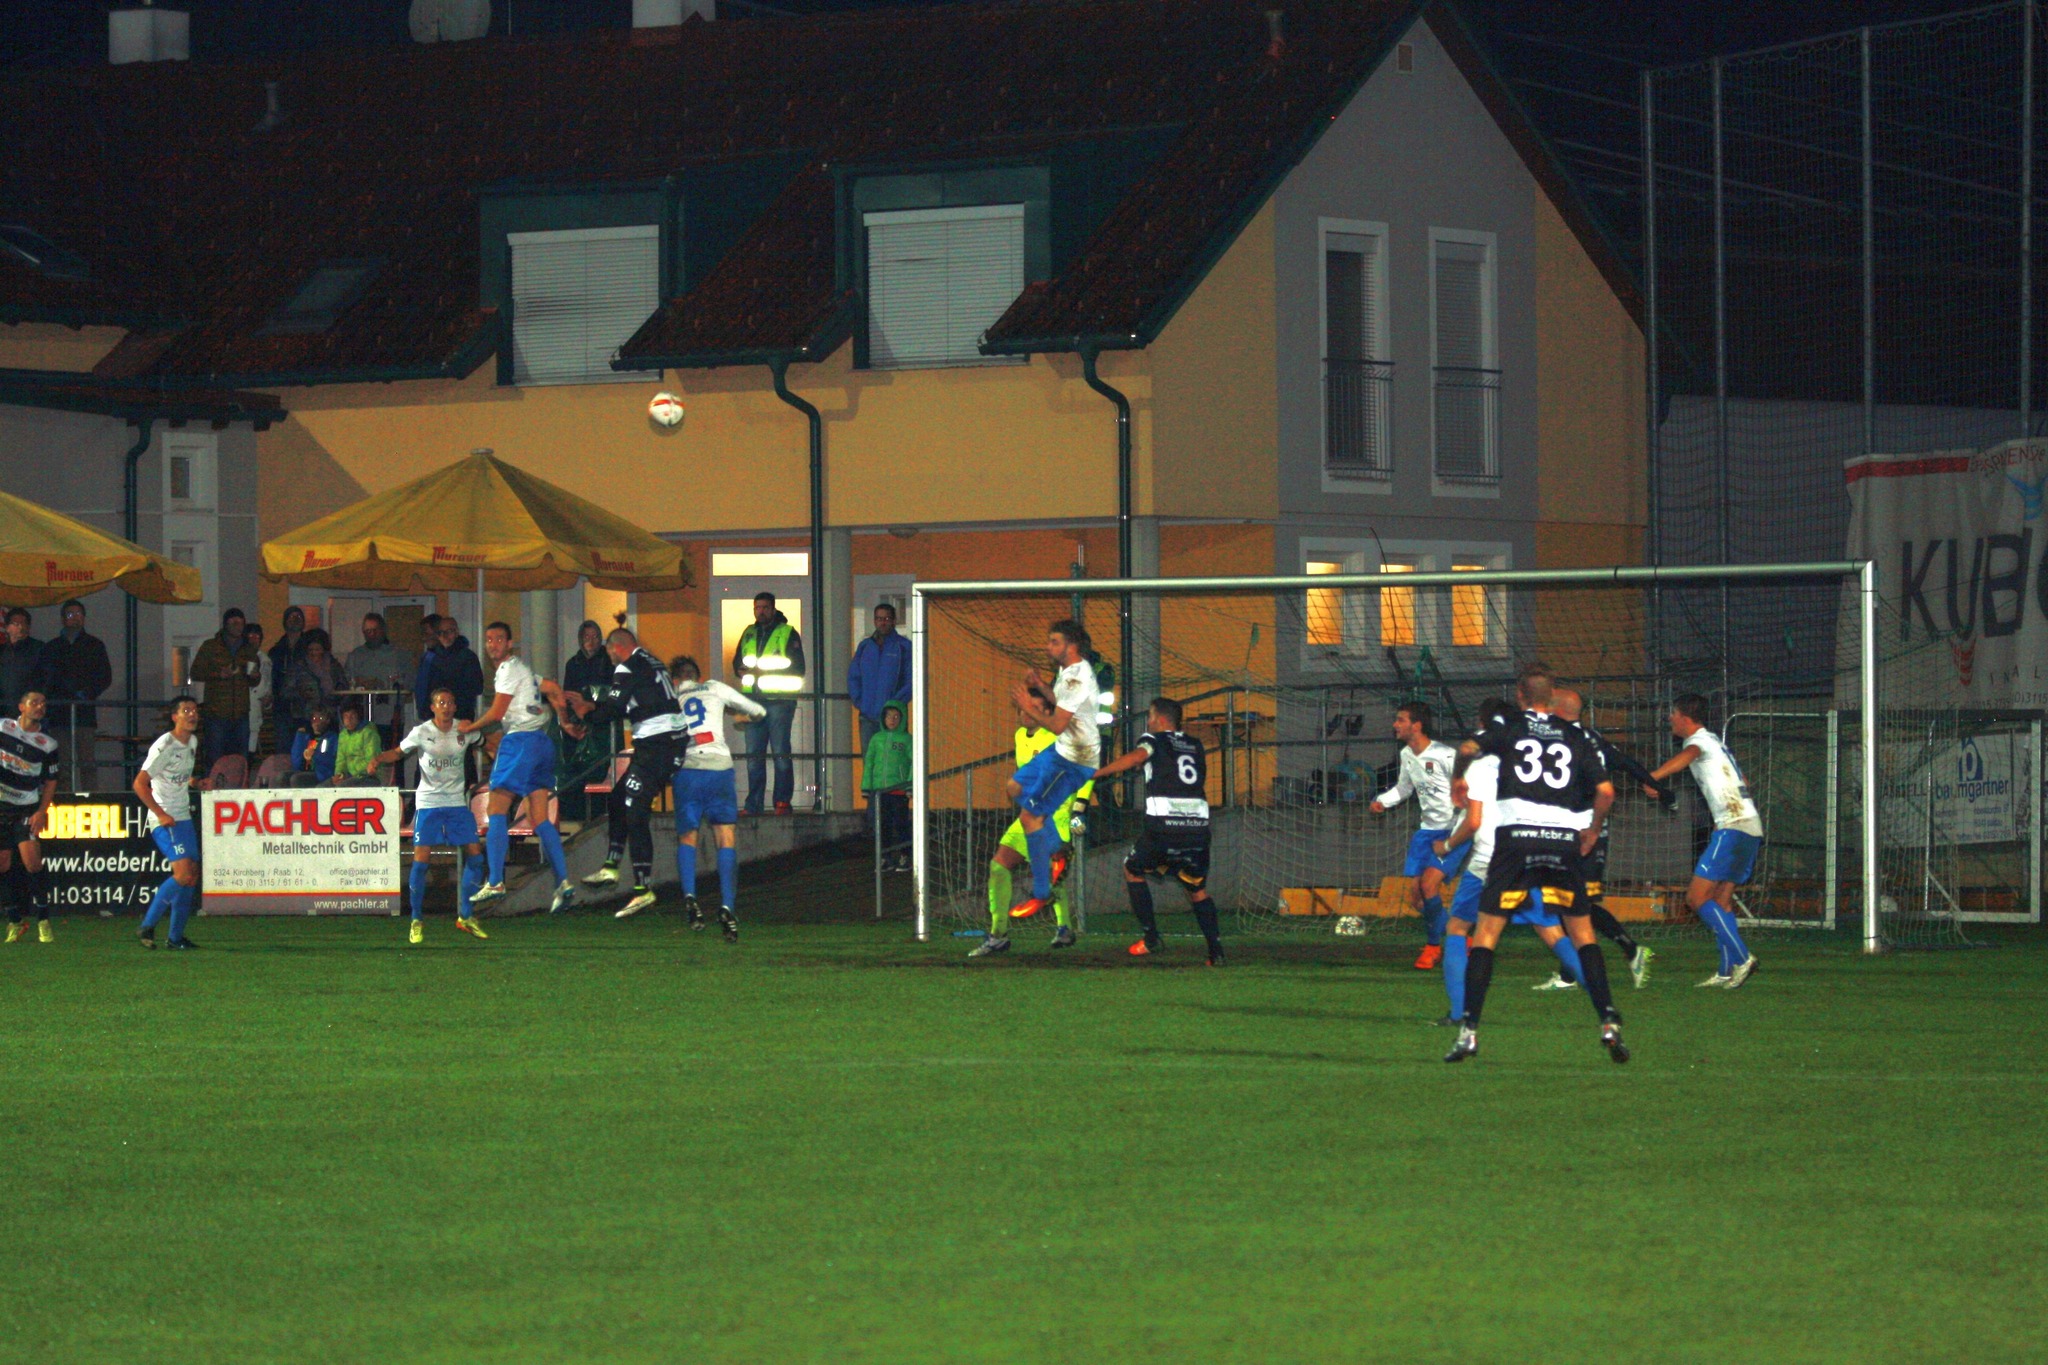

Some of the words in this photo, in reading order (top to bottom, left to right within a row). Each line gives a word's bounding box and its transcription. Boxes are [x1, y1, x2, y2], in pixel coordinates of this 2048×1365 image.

[684, 696, 707, 729] 9
[1177, 754, 1198, 785] 6
[1514, 738, 1573, 790] 33
[214, 798, 387, 836] PACHLER
[174, 843, 186, 856] 16
[263, 841, 345, 855] Metalltechnik
[349, 840, 388, 854] GmbH
[233, 867, 265, 878] Kirchberg
[379, 877, 389, 886] 70
[314, 898, 389, 911] www.pachler.at
